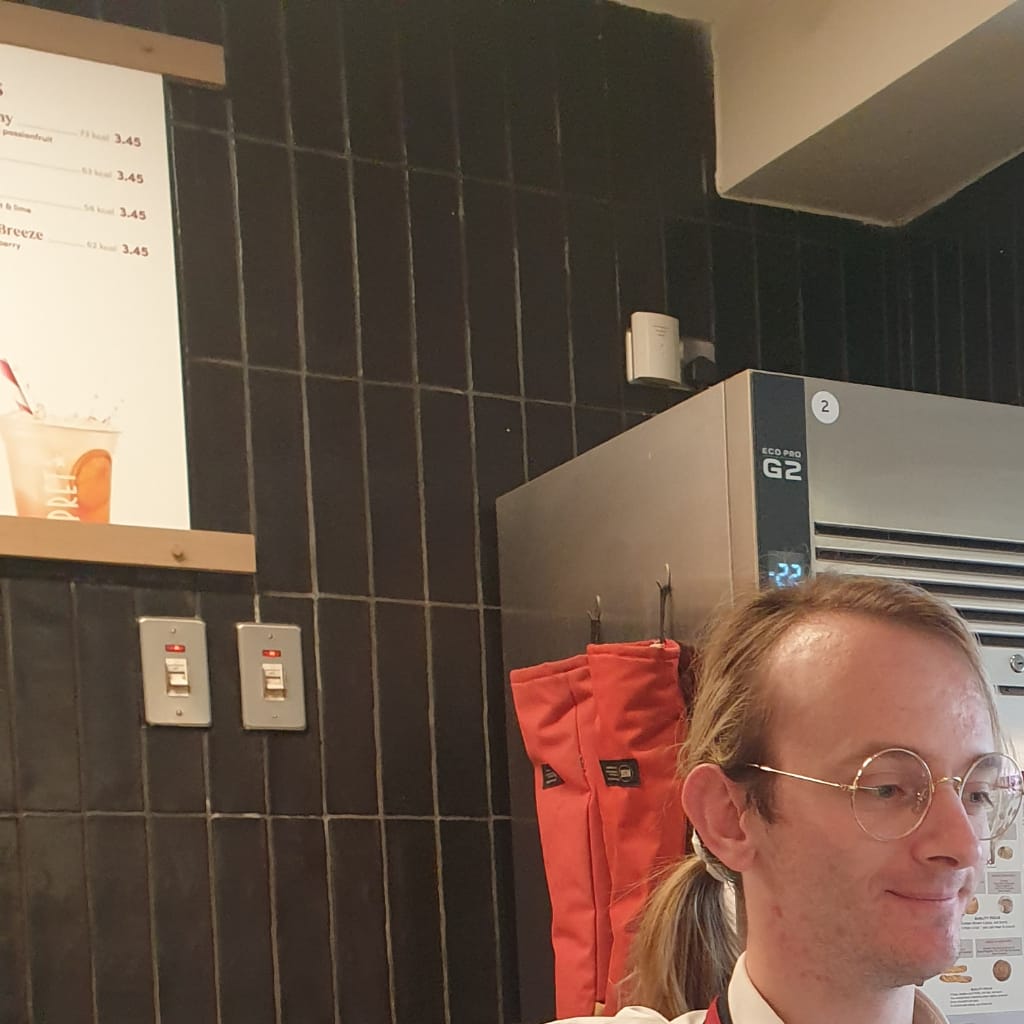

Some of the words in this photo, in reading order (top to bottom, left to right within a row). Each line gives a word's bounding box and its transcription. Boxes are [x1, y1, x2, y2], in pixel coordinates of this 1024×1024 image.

[114, 133, 142, 147] 3.45
[117, 170, 144, 184] 3.45
[120, 207, 147, 221] 3.45
[122, 244, 149, 257] 3.45
[820, 399, 830, 412] 2
[762, 447, 782, 457] ECO
[783, 449, 802, 459] PRO
[762, 458, 802, 481] G2
